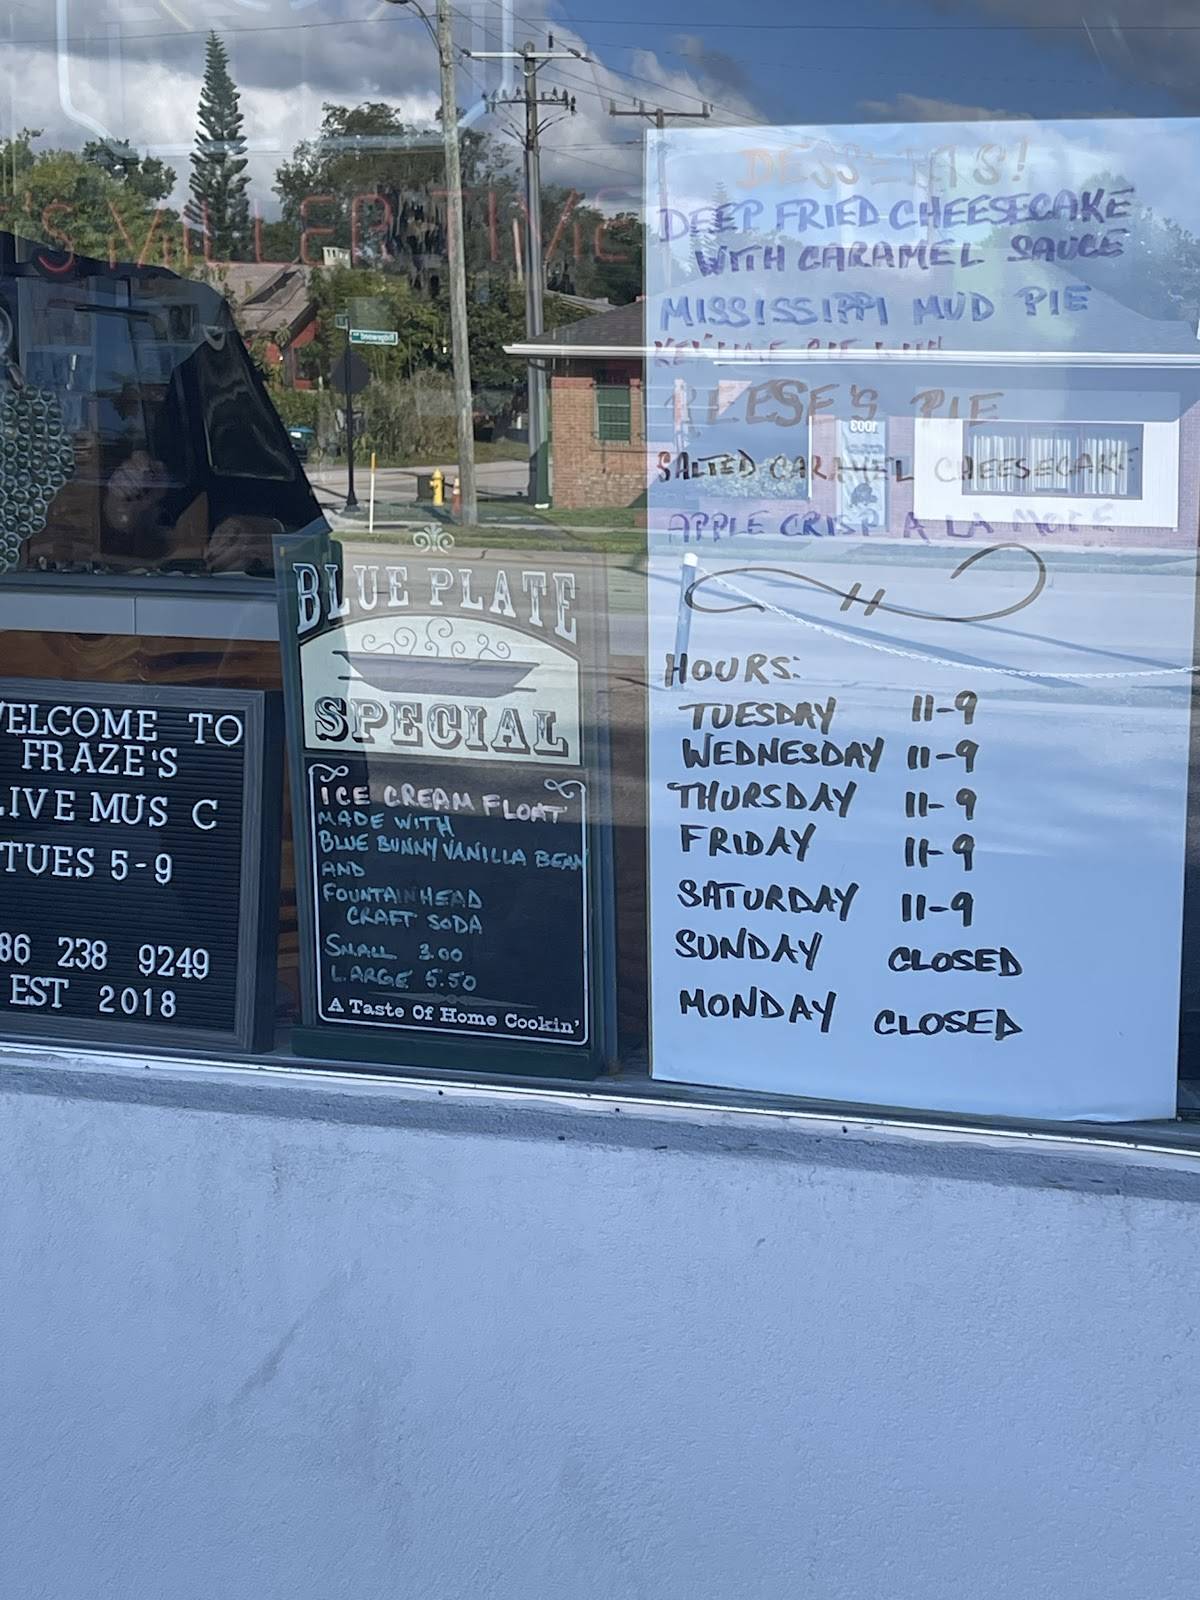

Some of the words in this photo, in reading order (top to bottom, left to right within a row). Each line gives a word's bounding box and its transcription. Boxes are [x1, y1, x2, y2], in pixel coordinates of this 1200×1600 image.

[656, 199, 764, 242] DEEP
[776, 194, 880, 232] FRIED
[888, 187, 1136, 230] CHEESECAKE
[694, 245, 786, 277] WITH
[798, 239, 985, 272] CARAMEL
[1007, 227, 1129, 262] SAUCE
[660, 291, 889, 331] MISSISSIPPI
[913, 291, 995, 326] MUD
[1014, 284, 1093, 316] PIE
[910, 389, 1005, 428] PIE
[657, 450, 756, 483] SALTED
[668, 511, 769, 544] APPLE
[779, 509, 880, 538] CRISP
[903, 511, 931, 545] A
[945, 513, 995, 539] LA
[293, 562, 410, 635] BLUE
[427, 567, 578, 645] PLATE
[664, 653, 801, 687] HOURS:
[188, 712, 244, 746] TO
[314, 697, 569, 757] SPECIAL
[678, 696, 836, 735] TUESDAY
[911, 690, 978, 725] 11-9
[21, 738, 179, 779] FRAZE'S
[682, 732, 885, 773] WEDNESDAY
[907, 739, 979, 774] 11-9
[0, 786, 77, 822] IVE
[320, 785, 371, 807] ICE
[384, 783, 474, 811] CREAM
[482, 794, 568, 824] FLOAT
[667, 781, 857, 818] THURSDAY
[905, 787, 978, 821] 11-9
[317, 810, 386, 829] MADE
[393, 814, 456, 838] WITH
[0, 841, 95, 880] TUES
[318, 830, 369, 854] BLUE
[376, 835, 437, 862] BUNNY
[442, 841, 528, 866] VANILLA
[680, 822, 817, 863] FRIDAY
[904, 833, 976, 872] 11-9
[321, 860, 366, 877] AND
[346, 905, 418, 928] CRAFT
[427, 913, 483, 935] SODA
[676, 879, 859, 922] SATURDAY
[901, 891, 975, 928] 11-9
[57, 936, 109, 971] 238
[137, 943, 211, 981] 9249
[675, 927, 823, 971] SUNDAY
[887, 946, 1023, 977] CLOSED
[9, 973, 70, 1009] EST
[98, 983, 178, 1019] 2018
[424, 967, 477, 992] 5.50
[328, 998, 345, 1013] A
[349, 1000, 405, 1018] Taste
[412, 1004, 434, 1021] Of
[440, 1007, 498, 1027] Home
[504, 1013, 580, 1035] Cookin'
[679, 986, 837, 1033] MONDAY
[873, 1009, 1023, 1041] CLOSED
